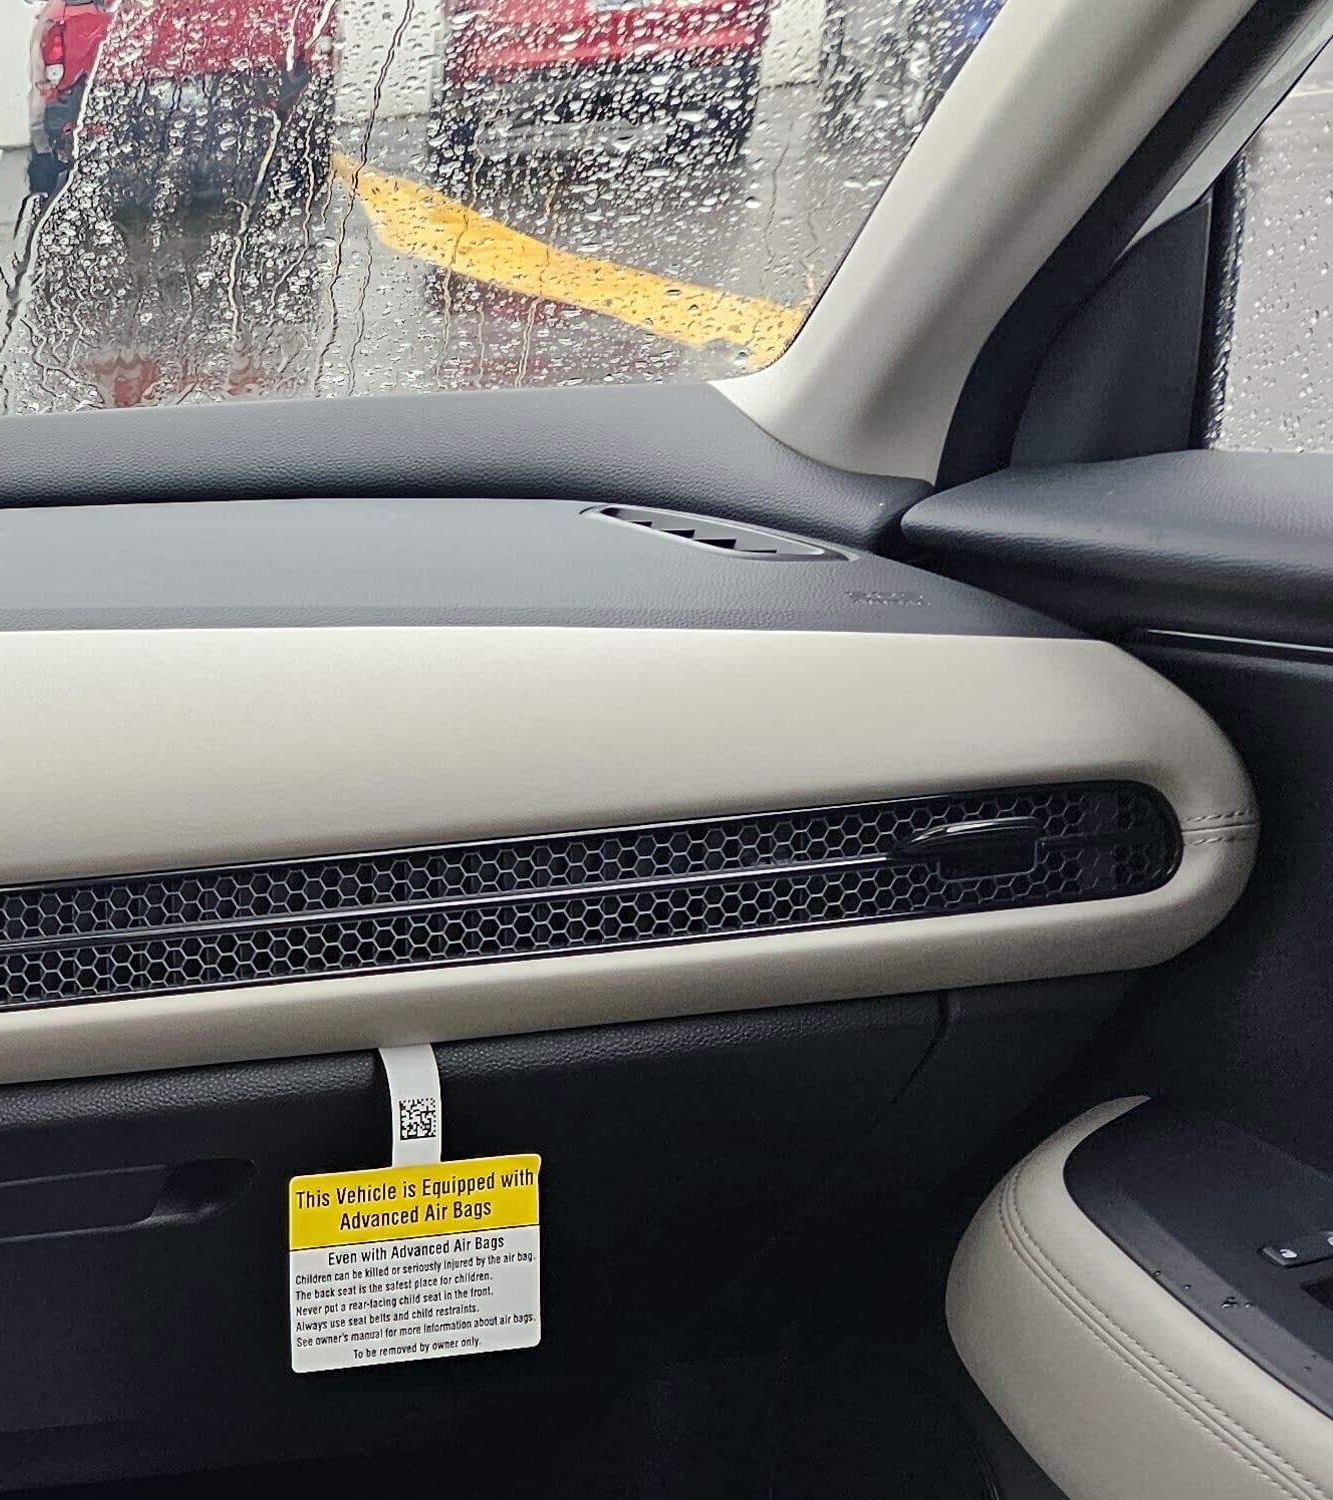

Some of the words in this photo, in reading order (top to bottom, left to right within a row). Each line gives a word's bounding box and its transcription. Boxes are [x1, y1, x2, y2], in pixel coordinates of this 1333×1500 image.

[296, 1190, 330, 1209] This
[336, 1183, 397, 1205] Vehicle
[403, 1181, 416, 1198] is
[422, 1172, 495, 1199] Equipped
[501, 1168, 534, 1188] with
[340, 1205, 419, 1231] Advanced
[424, 1203, 448, 1222] Air
[453, 1201, 491, 1220] Bags
[329, 1252, 357, 1266] Even
[361, 1247, 387, 1262] with
[391, 1240, 450, 1260] Advanced
[454, 1238, 472, 1253] Air
[475, 1237, 505, 1251] Bags
[295, 1274, 332, 1286] Children
[334, 1272, 350, 1281] can
[352, 1269, 363, 1280] be
[365, 1266, 389, 1278] killed
[392, 1267, 401, 1275] or
[403, 1261, 442, 1274] seriously
[444, 1257, 474, 1271] injured
[476, 1256, 486, 1268] by
[487, 1255, 501, 1265] the
[503, 1253, 516, 1263] air
[517, 1252, 535, 1263] bag.
[296, 1290, 312, 1301] The
[315, 1287, 335, 1299] back
[338, 1285, 357, 1297] seat
[359, 1284, 367, 1295] is
[369, 1283, 383, 1293] the
[386, 1279, 412, 1292] safest
[414, 1278, 438, 1291] place
[440, 1276, 452, 1286] for
[454, 1272, 493, 1284] children.
[296, 1306, 323, 1316] Never
[324, 1303, 339, 1316] put
[341, 1304, 346, 1312] a
[349, 1297, 397, 1311] rear-facing
[399, 1294, 421, 1306] child
[423, 1292, 442, 1303] seat
[444, 1290, 452, 1300] in
[454, 1289, 468, 1299] the
[470, 1286, 494, 1297] front.
[296, 1321, 328, 1332] Always
[330, 1319, 346, 1329] use
[348, 1316, 367, 1327] seat
[369, 1313, 391, 1325] belts
[393, 1310, 409, 1322] and
[412, 1308, 433, 1320] child
[436, 1304, 480, 1317] restraints.
[297, 1337, 313, 1348] See
[316, 1332, 349, 1346] owner's
[351, 1328, 383, 1342] manual
[385, 1328, 398, 1338] for
[400, 1326, 421, 1336] more
[424, 1320, 472, 1333] information
[474, 1316, 498, 1328] about
[500, 1315, 512, 1326] air
[513, 1314, 536, 1324] bags.
[353, 1349, 364, 1359] To
[366, 1348, 377, 1358] be
[379, 1343, 417, 1357] removed
[420, 1342, 430, 1354] by
[432, 1340, 459, 1351] owner
[461, 1336, 482, 1348] only.
